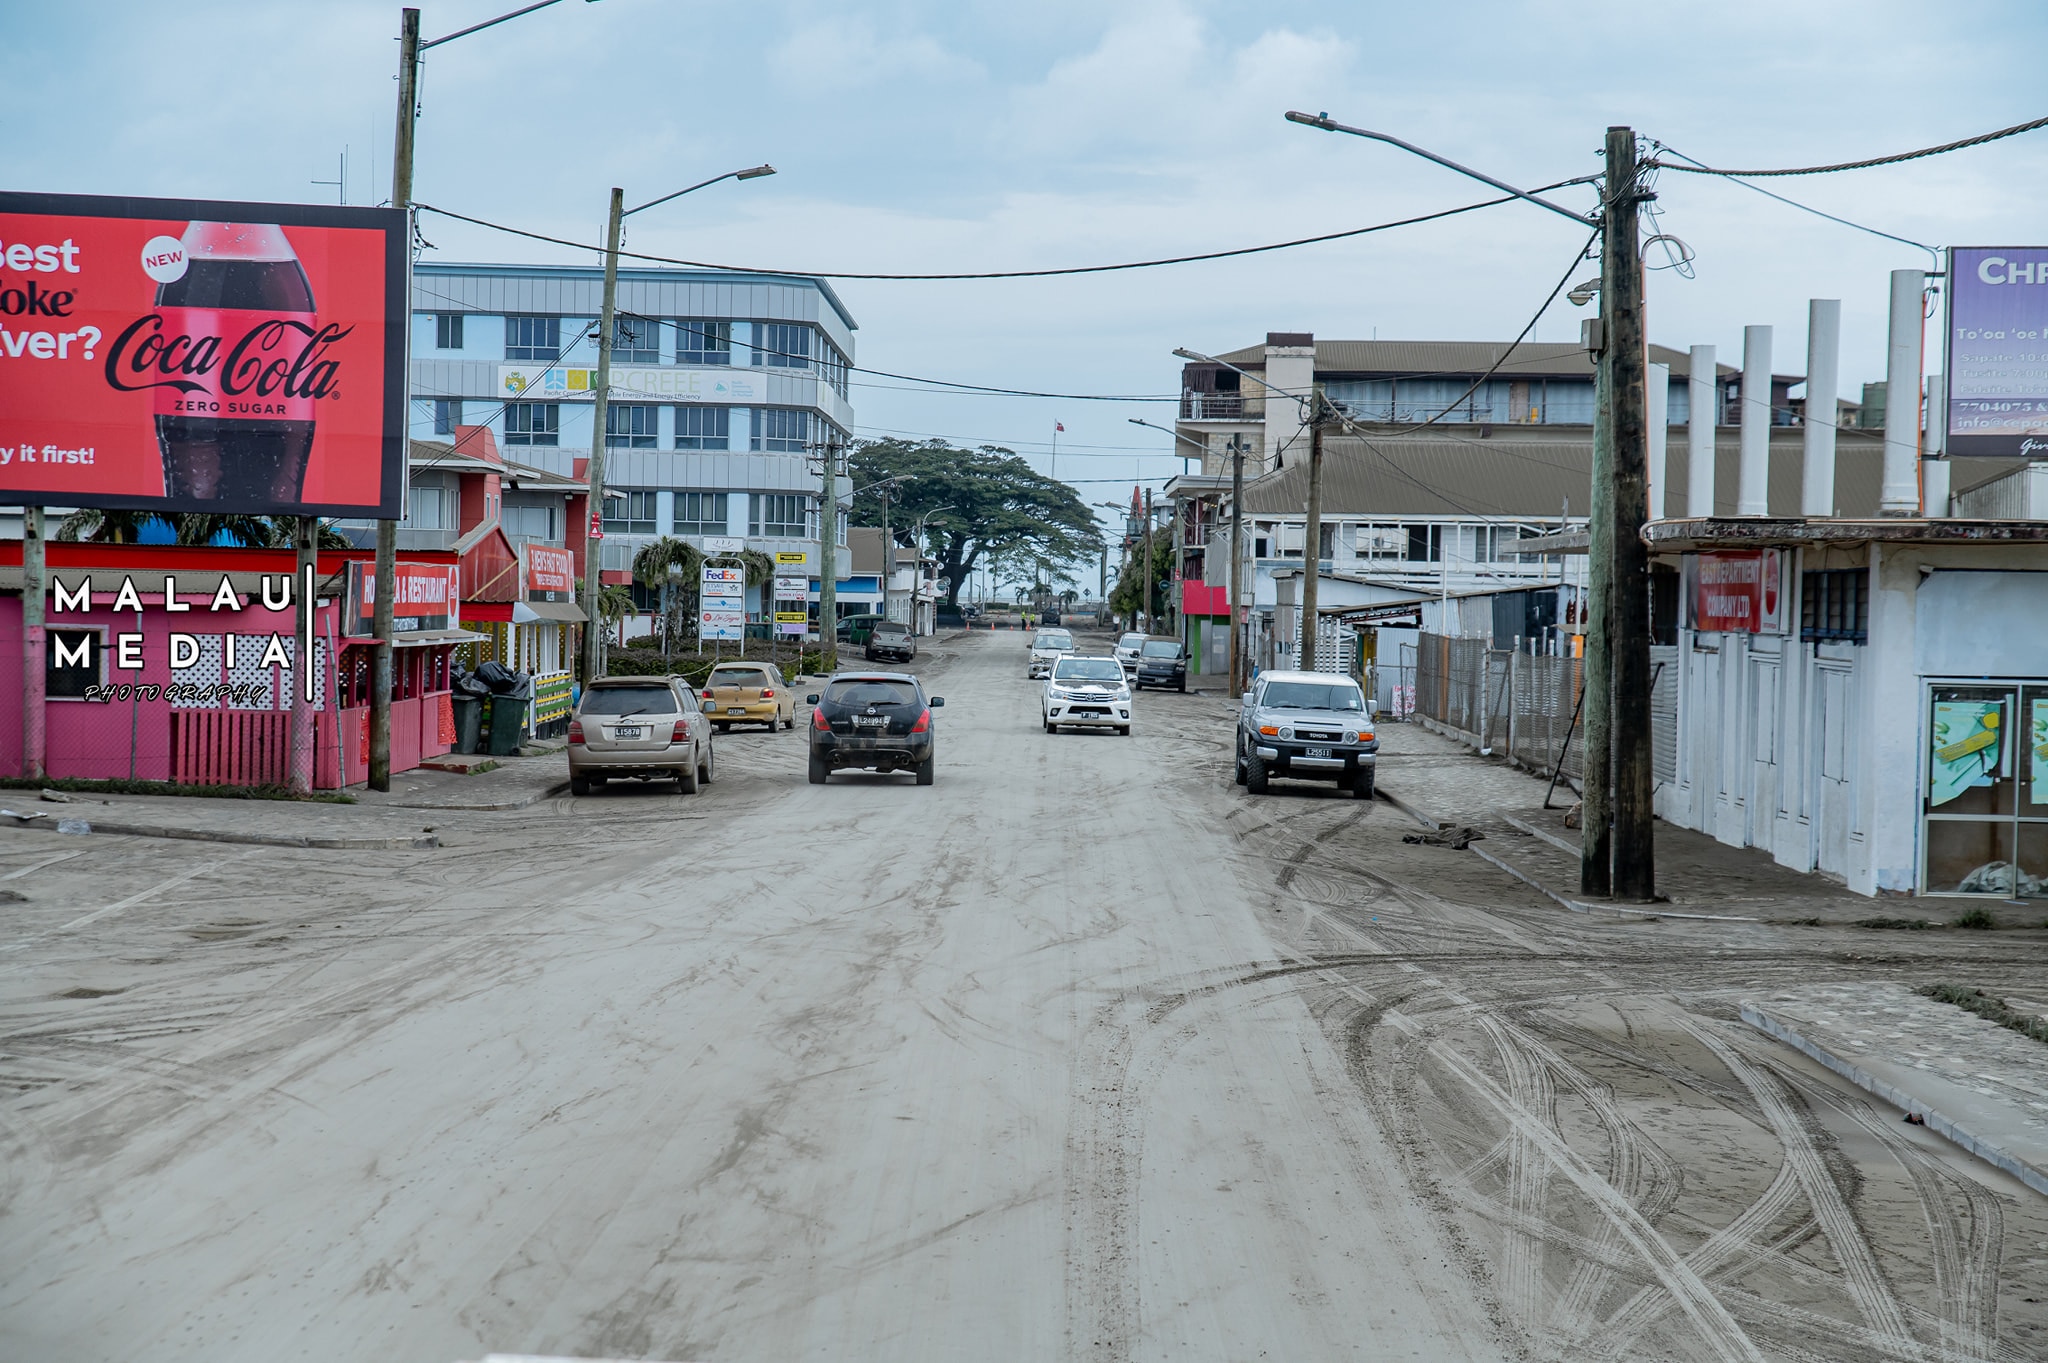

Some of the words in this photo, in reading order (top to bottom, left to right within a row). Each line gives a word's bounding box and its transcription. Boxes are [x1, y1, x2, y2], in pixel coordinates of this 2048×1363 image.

[0, 238, 81, 273] est
[145, 250, 182, 269] NEW
[0, 279, 75, 317] oke
[0, 322, 102, 361] ver?
[175, 400, 220, 412] ZERO
[228, 402, 287, 414] SUGAR
[20, 443, 36, 463] it
[41, 444, 95, 465] first!
[706, 570, 736, 580] FedEx
[401, 575, 407, 604] &
[407, 576, 447, 604] RESTAURANT
[1707, 595, 1737, 617] COMPANY
[1737, 595, 1750, 617] LTD
